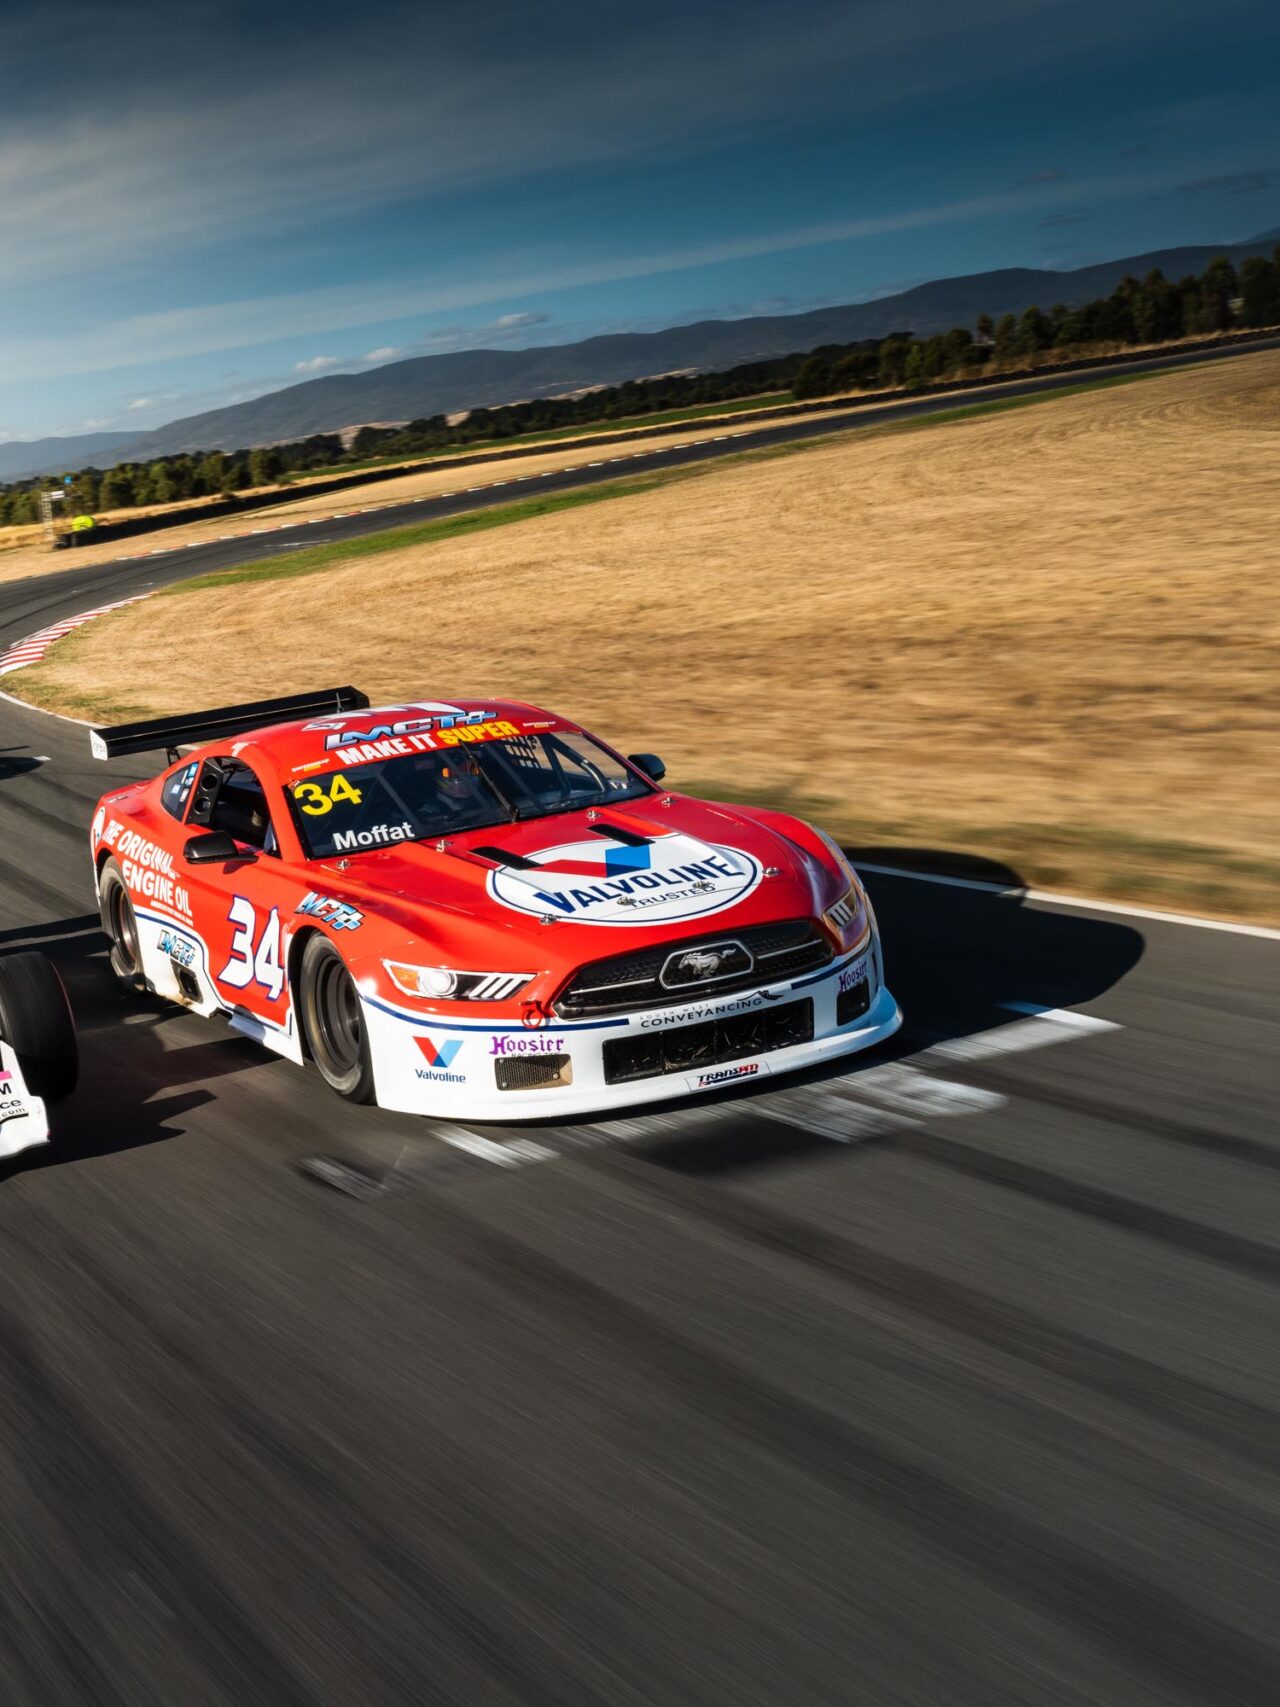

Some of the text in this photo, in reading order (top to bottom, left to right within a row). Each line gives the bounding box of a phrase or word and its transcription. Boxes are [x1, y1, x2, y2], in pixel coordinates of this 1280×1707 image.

[336, 721, 521, 765] MAKE IT SUPER
[293, 774, 362, 816] 34
[117, 830, 179, 880] ORIGINAL
[333, 821, 415, 850] Moffat
[122, 859, 174, 906] ENGINE
[175, 886, 193, 917] OIL
[533, 855, 745, 914] VALVOLINE
[217, 895, 285, 1002] 34
[641, 997, 762, 1028] CONVEYANCING
[489, 1034, 565, 1055] Hoosier
[415, 1069, 466, 1083] Valvoline
